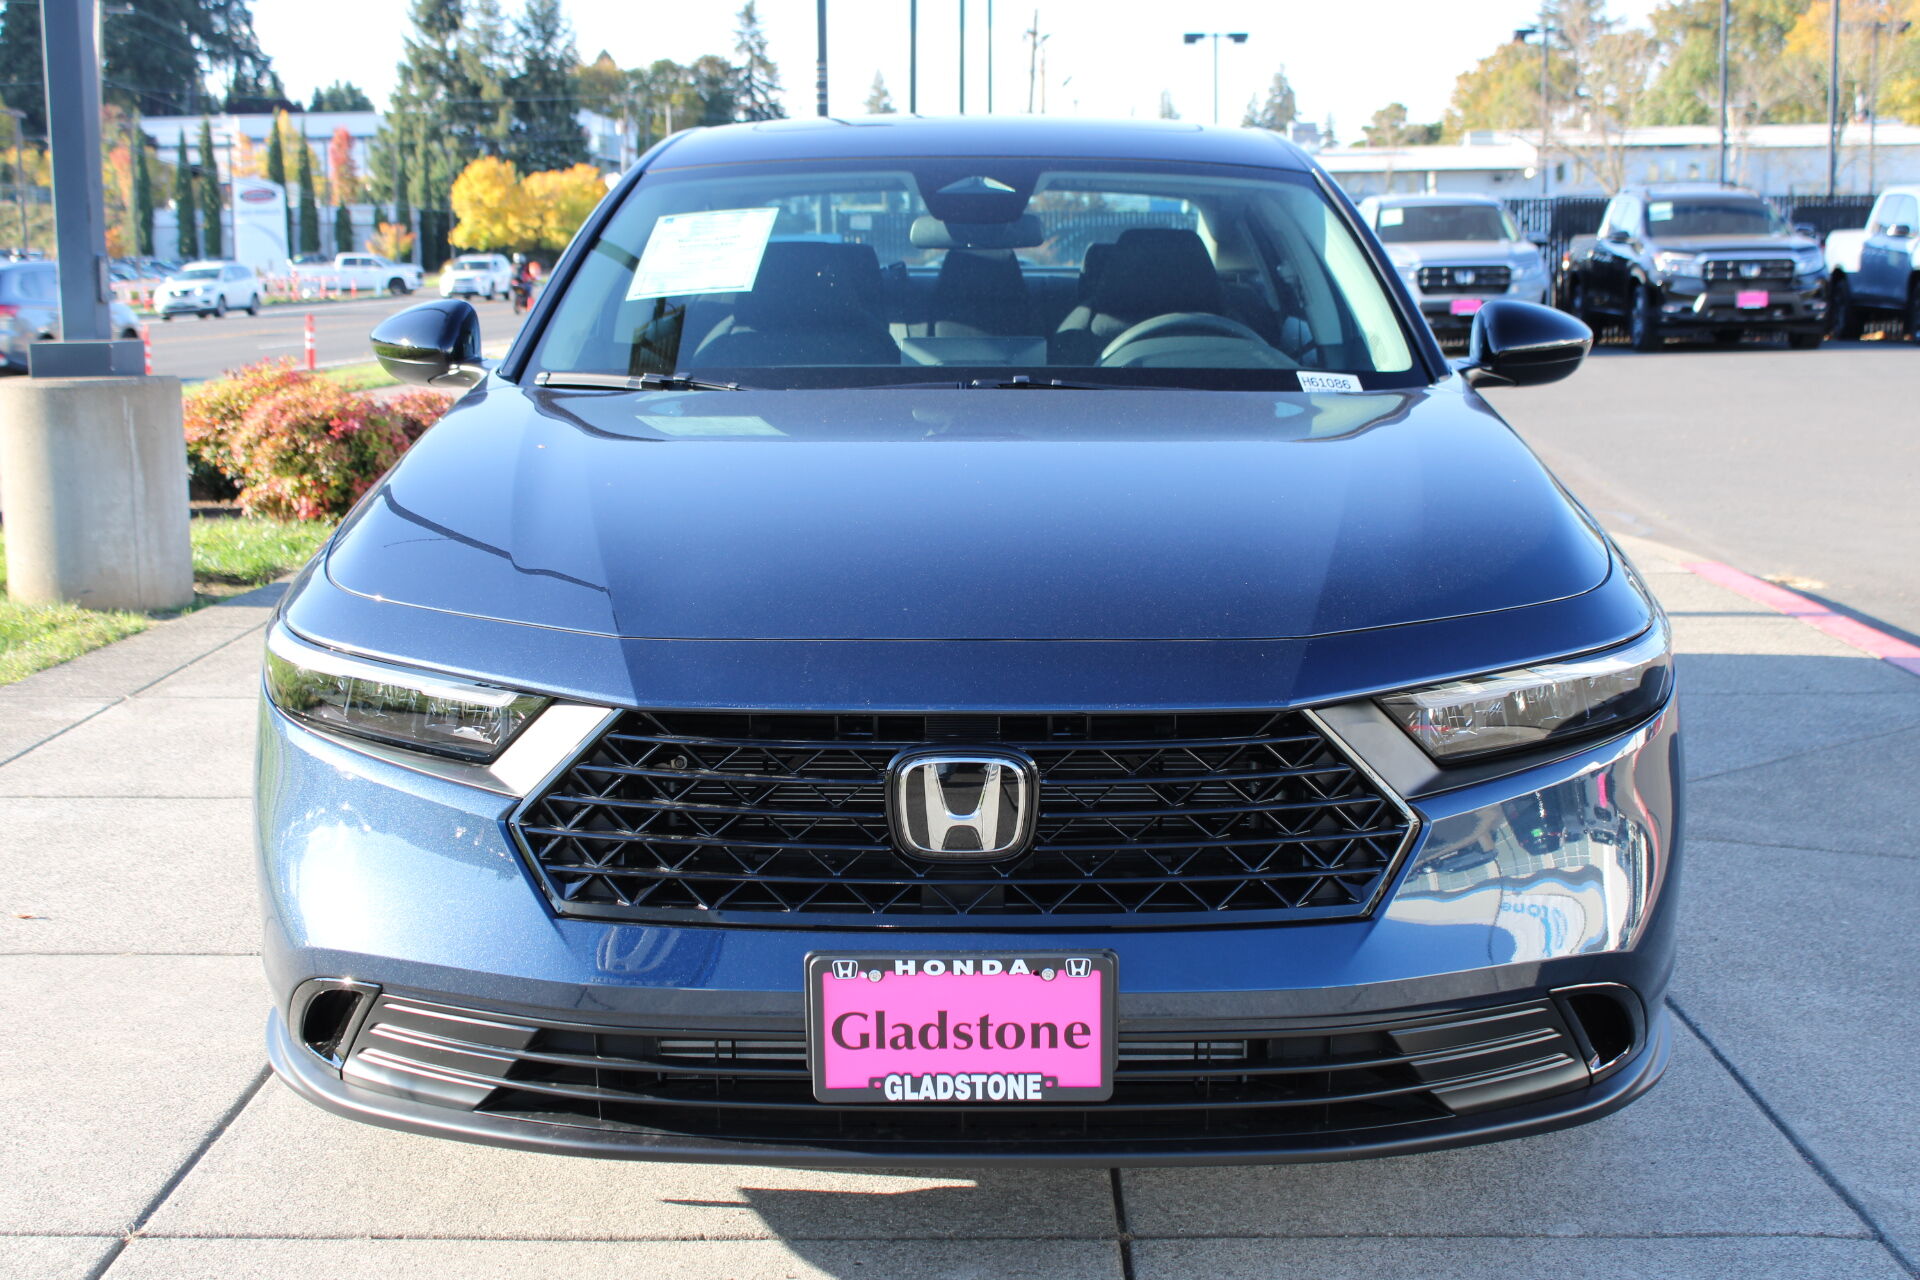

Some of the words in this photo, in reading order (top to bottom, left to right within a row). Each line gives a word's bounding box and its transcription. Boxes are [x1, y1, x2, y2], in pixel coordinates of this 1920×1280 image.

[1301, 376, 1351, 389] H61086
[894, 959, 1031, 976] HONDA
[831, 1010, 1091, 1050] Gladstone
[884, 1073, 1042, 1101] GLADSTONE
